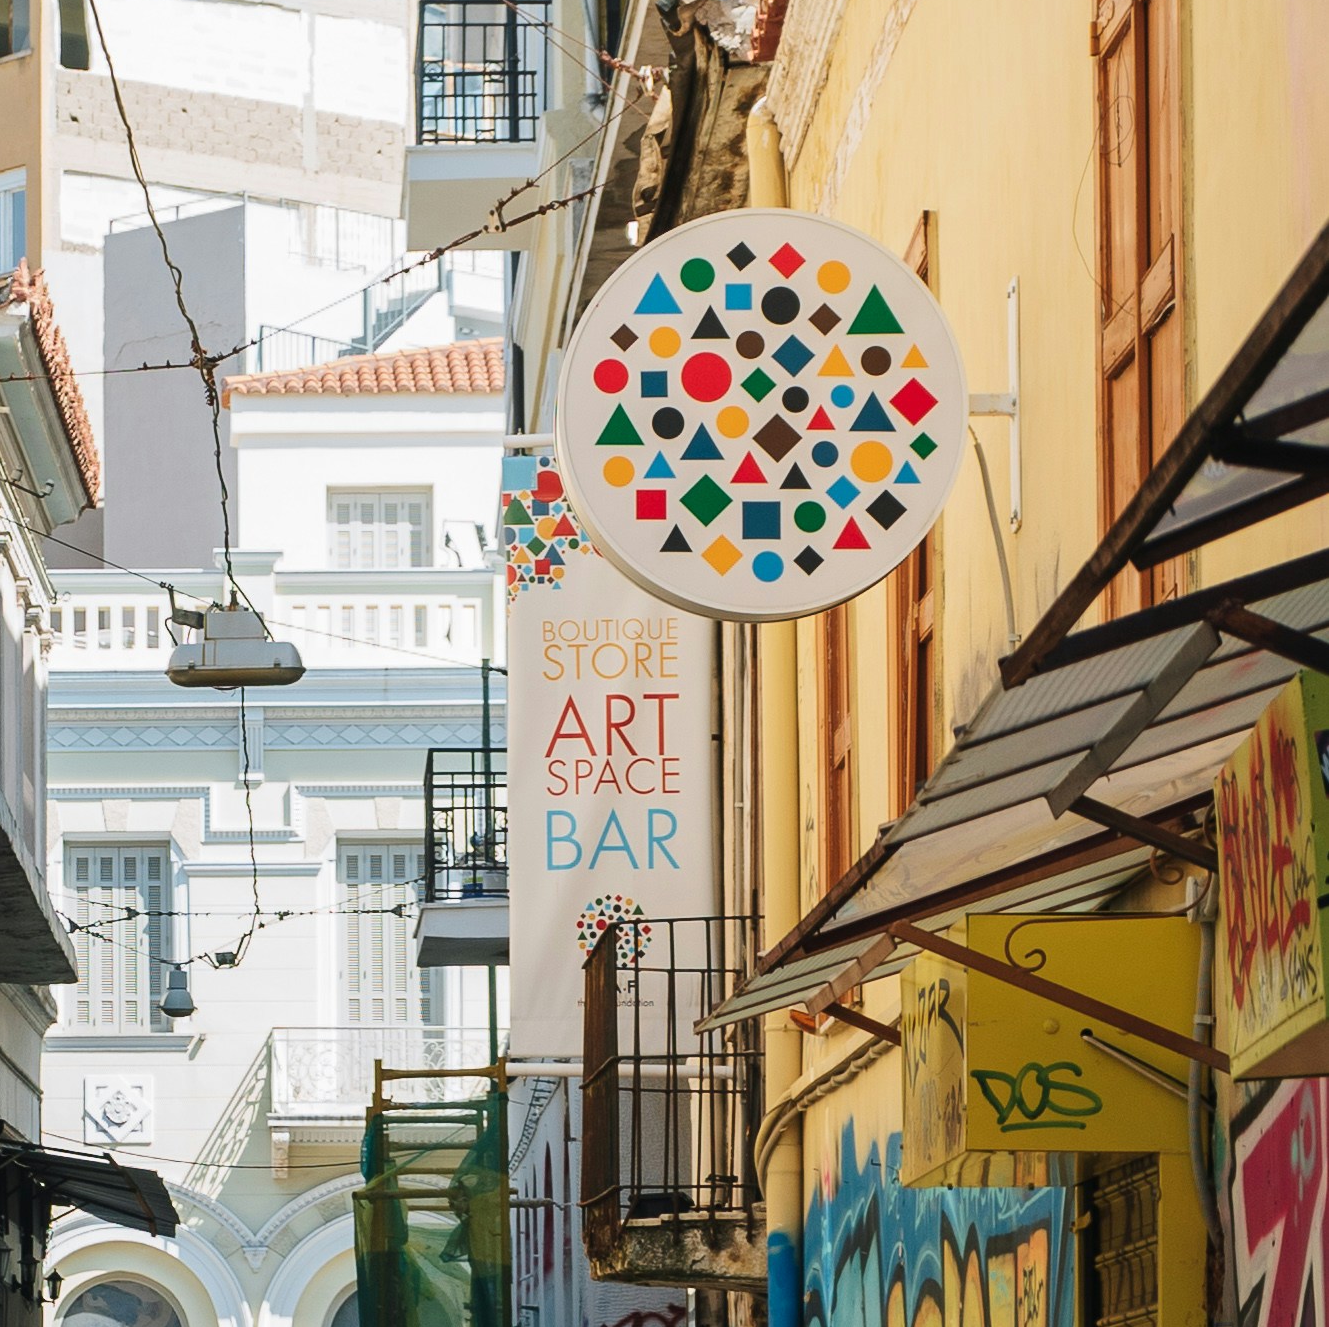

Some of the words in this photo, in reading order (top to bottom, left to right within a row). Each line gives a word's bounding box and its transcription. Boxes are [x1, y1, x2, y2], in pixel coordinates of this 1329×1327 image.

[542, 617, 679, 643] BOUTIQUE
[542, 642, 679, 681] STORE
[544, 693, 680, 758] ART
[546, 757, 681, 796] SPACE
[546, 808, 681, 871] BAR
[971, 1061, 1103, 1126] DOS
